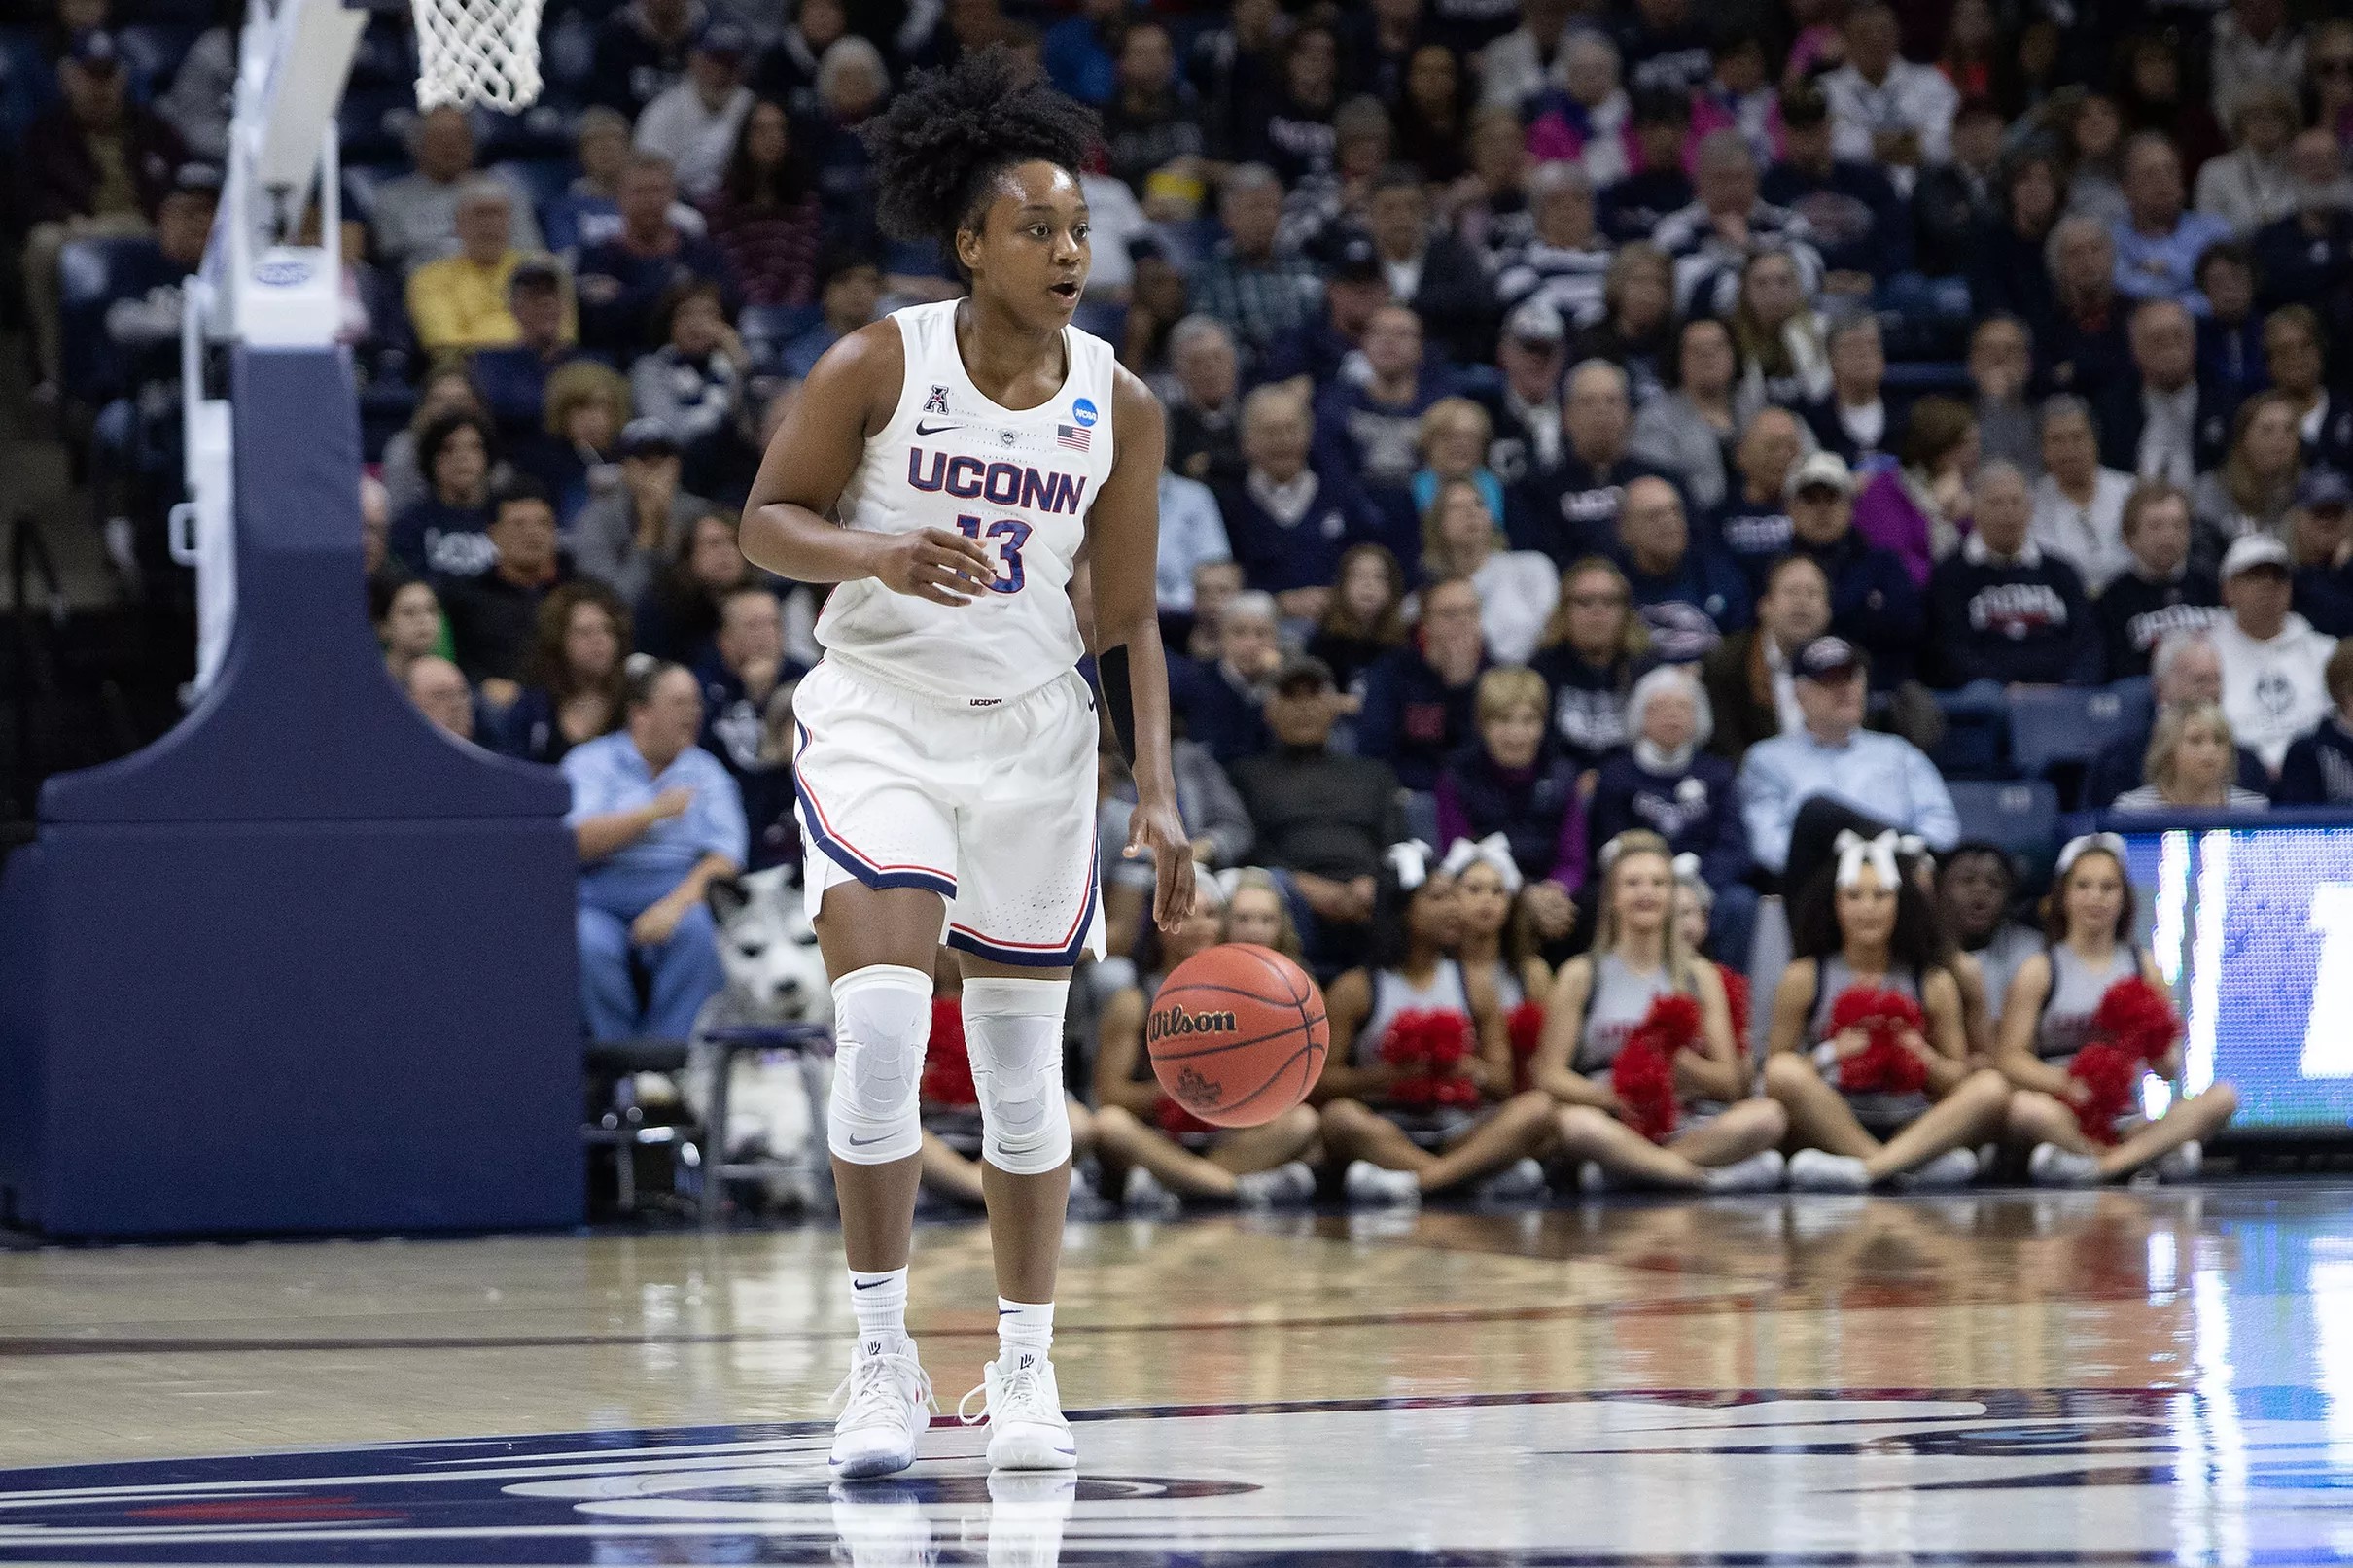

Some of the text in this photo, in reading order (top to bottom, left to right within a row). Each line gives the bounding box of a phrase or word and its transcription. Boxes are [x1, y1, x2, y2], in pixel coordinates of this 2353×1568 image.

[1075, 407, 1098, 422] NCAA
[907, 446, 1087, 515] UCONN
[969, 698, 1002, 707] UCONN
[1147, 1004, 1238, 1044] Wilson
